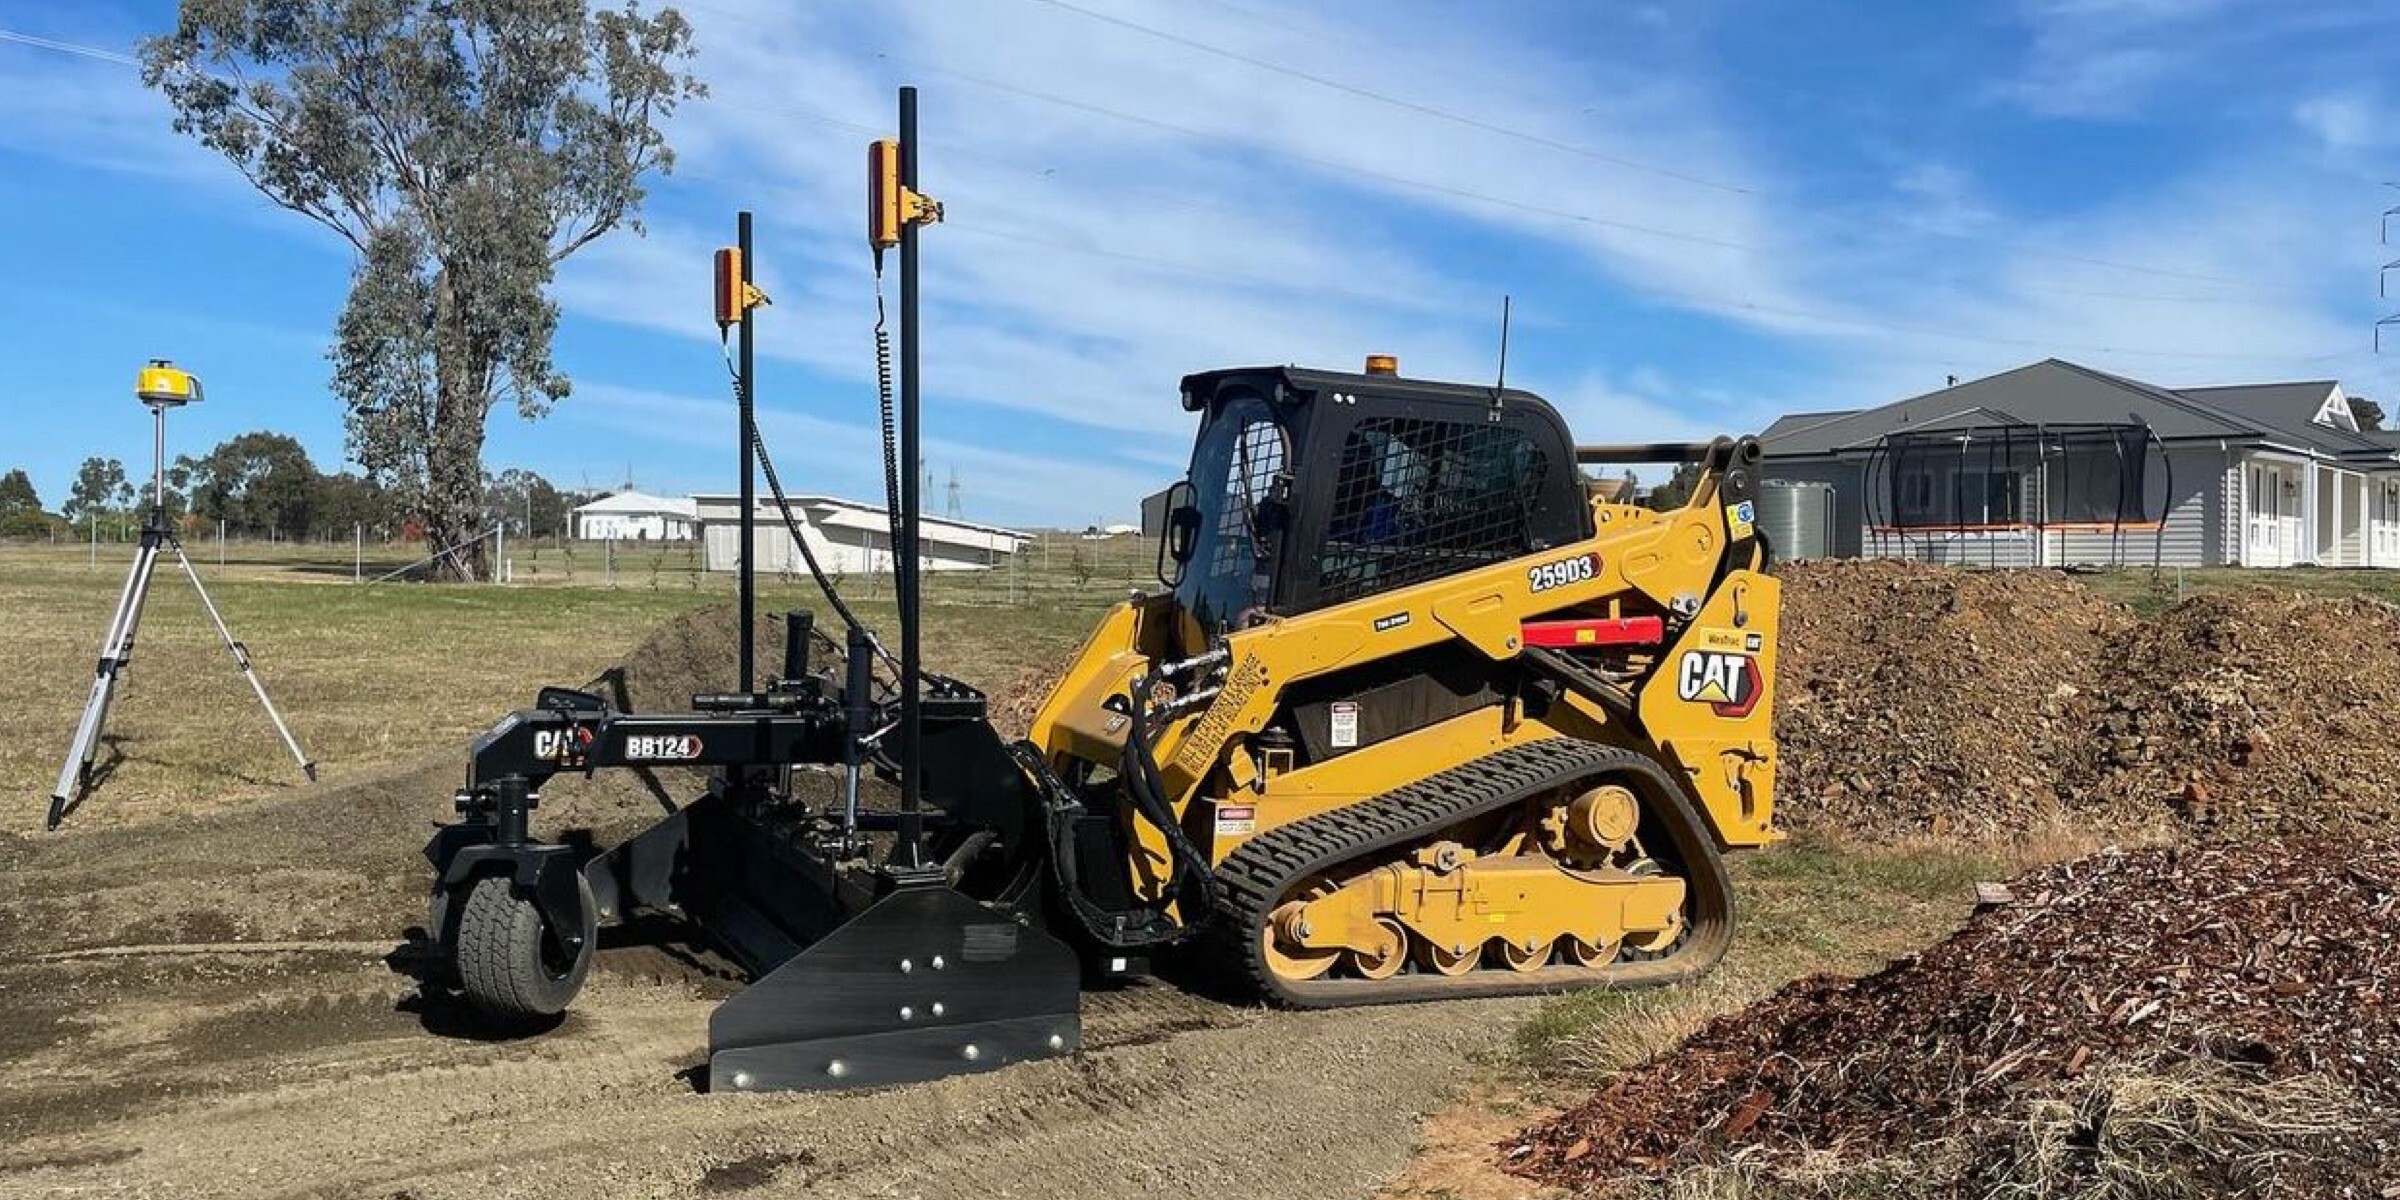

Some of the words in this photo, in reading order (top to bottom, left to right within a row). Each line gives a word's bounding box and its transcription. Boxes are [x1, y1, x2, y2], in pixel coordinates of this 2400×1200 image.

[1529, 556, 1593, 592] 259D3
[1680, 652, 1745, 702] CAT
[627, 736, 690, 757] BB124
